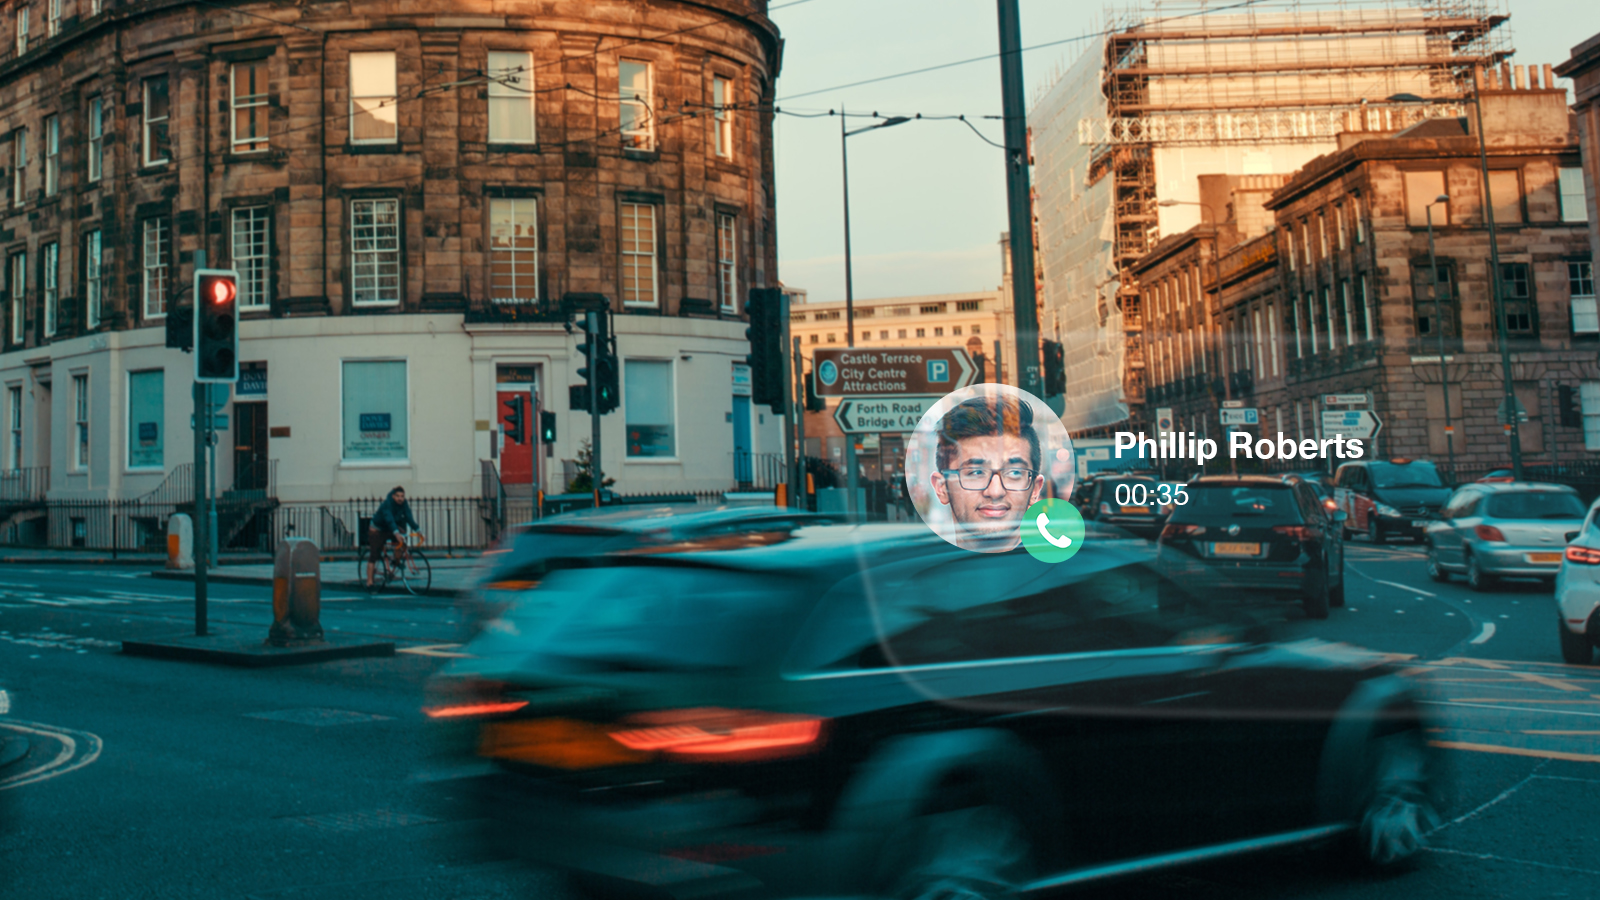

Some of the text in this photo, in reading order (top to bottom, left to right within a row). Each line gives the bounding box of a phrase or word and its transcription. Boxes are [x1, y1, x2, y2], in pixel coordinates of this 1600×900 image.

[840, 353, 922, 365] Castle Terrace
[841, 368, 907, 380] City Centre
[932, 362, 946, 380] P
[842, 380, 907, 391] Attractions
[857, 403, 922, 414] Forth Road
[857, 416, 895, 428] Bridge
[1247, 411, 1255, 422] P
